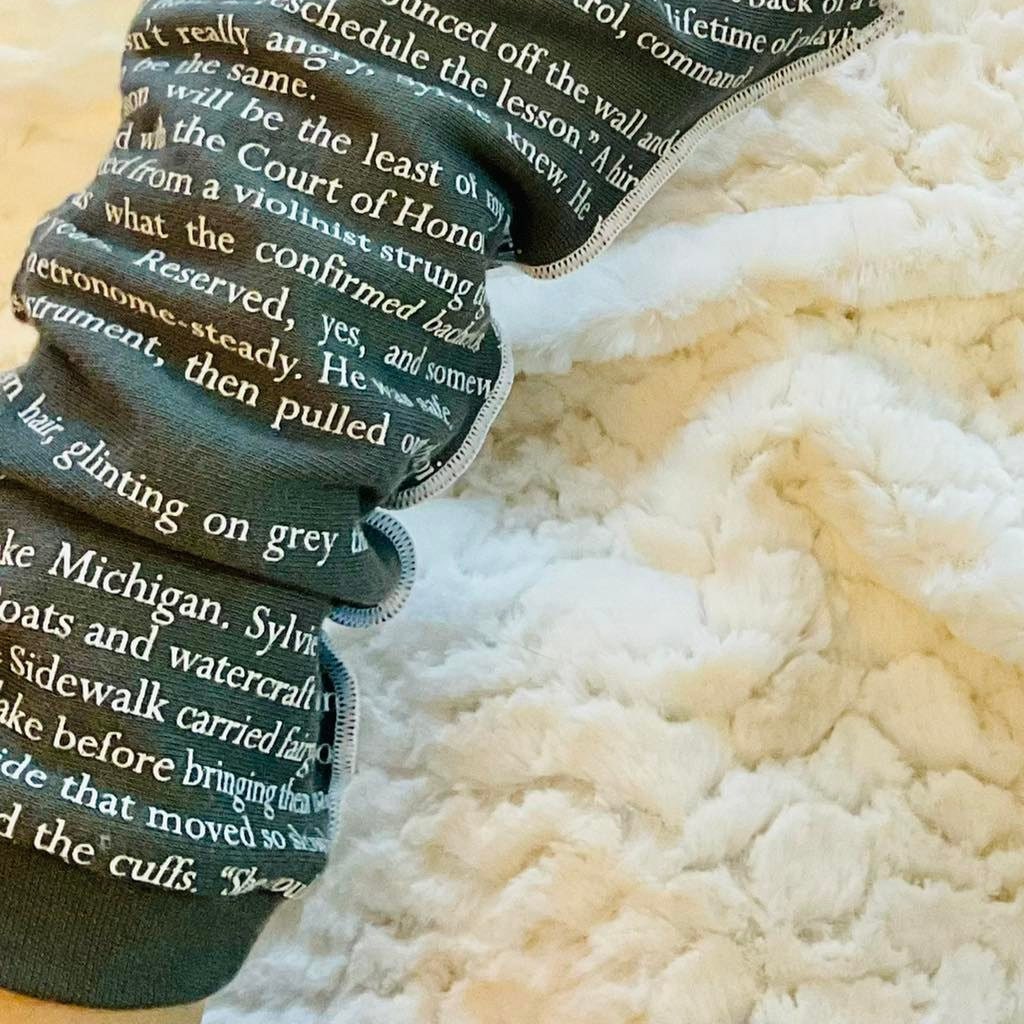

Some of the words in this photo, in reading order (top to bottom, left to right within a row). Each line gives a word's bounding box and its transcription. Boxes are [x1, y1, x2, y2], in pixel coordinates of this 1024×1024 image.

[175, 53, 221, 75] the
[226, 62, 316, 101] same.
[637, 32, 754, 89] command
[663, 3, 767, 53] lifetime
[771, 28, 803, 56] of
[168, 84, 234, 111] will
[240, 97, 284, 131] be
[297, 116, 352, 154] the
[361, 132, 443, 187] least
[455, 172, 478, 199] of
[176, 14, 250, 54] really
[567, 179, 593, 221] He
[440, 56, 489, 97] the
[590, 146, 612, 174] A
[497, 41, 549, 75] off
[545, 60, 590, 104] the
[595, 94, 648, 140] wall
[637, 129, 680, 157] and
[172, 115, 226, 153] the
[238, 142, 343, 204] Court
[350, 189, 398, 219] of
[103, 196, 168, 238] what
[186, 216, 235, 254] the
[255, 241, 426, 321] confirmed
[127, 158, 192, 195] from
[202, 178, 220, 201] a
[234, 183, 373, 253] violinist
[380, 245, 474, 311] strung
[133, 248, 296, 332] Reserved,
[318, 313, 367, 358] yes,
[383, 345, 428, 376] and
[184, 352, 261, 407] then
[270, 396, 391, 446] pulled
[319, 351, 368, 391] He
[18, 393, 65, 446] hair,
[52, 440, 189, 535] glinting
[203, 513, 250, 542] on
[262, 525, 339, 566] grey
[48, 542, 229, 629] Michigan.
[10, 645, 170, 723] Sidewalk
[177, 704, 283, 755] carried
[84, 622, 159, 662] and
[170, 645, 316, 710] watercraft
[53, 716, 175, 781] before
[183, 748, 278, 819] bringing
[60, 773, 136, 821] that
[146, 806, 256, 848] moved
[262, 828, 286, 850] so
[33, 819, 95, 865] the
[109, 854, 198, 894] cuffs.
